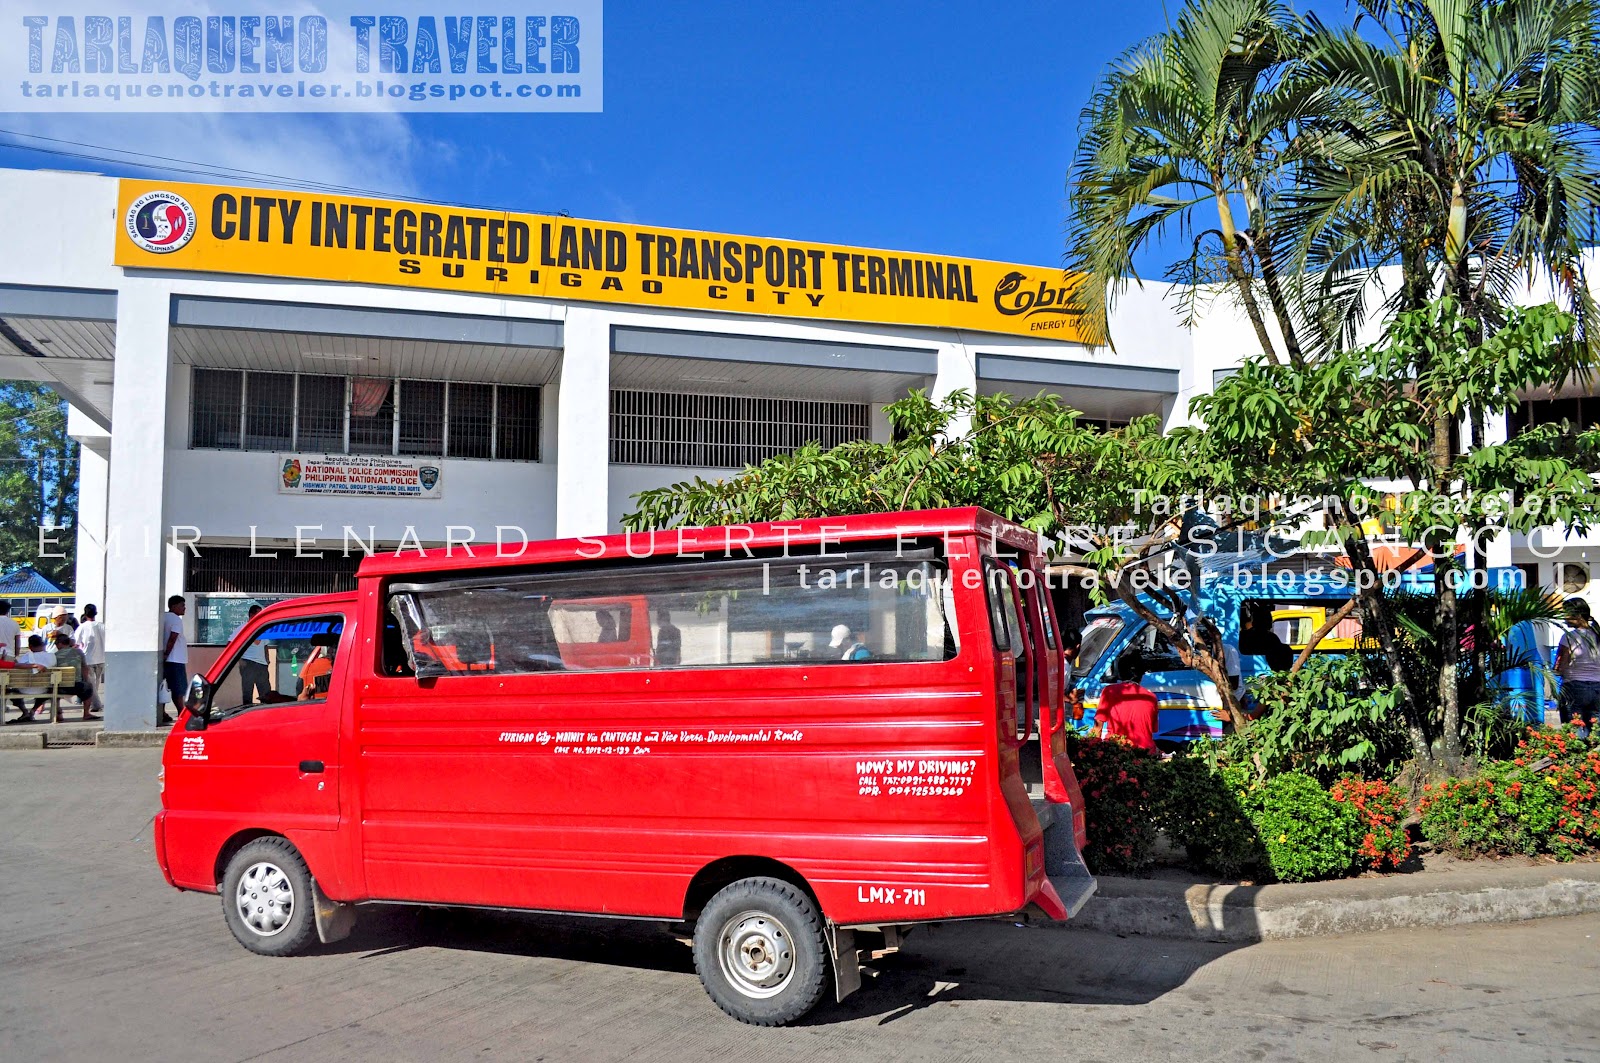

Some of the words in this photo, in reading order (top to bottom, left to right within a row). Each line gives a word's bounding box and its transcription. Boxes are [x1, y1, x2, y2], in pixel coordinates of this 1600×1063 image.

[135, 199, 145, 209] NG
[145, 193, 180, 203] LUNGSOD
[180, 201, 190, 211] NG
[145, 243, 175, 252] PILIPINAS
[211, 193, 302, 244] CITY
[310, 201, 530, 264] INTEGRATED
[541, 223, 627, 273] LAND
[636, 232, 826, 290] TRANSPORT
[832, 252, 978, 303] TERMINAL
[399, 258, 663, 294] SURIGAO
[708, 284, 825, 307] CITY
[994, 271, 1084, 316] Cobr
[1030, 320, 1067, 331] ENERGY
[305, 466, 344, 474] NATIONAL
[348, 467, 372, 475] POLICE
[374, 468, 418, 477] COMMISSION
[305, 474, 347, 482] PHILIPPINE
[349, 475, 388, 484] NATIONAL
[391, 477, 418, 485] POLICE
[498, 732, 535, 743] SURIGAO
[586, 733, 598, 742] Via
[644, 731, 660, 742] and
[661, 731, 678, 742] Vice
[774, 729, 803, 741] Route
[856, 759, 894, 775] HOW'S
[896, 760, 915, 774] MY
[918, 760, 976, 775] DRIVING?
[858, 776, 877, 786] CALL
[858, 786, 882, 796] OPR.
[857, 886, 926, 906] LMX-711
